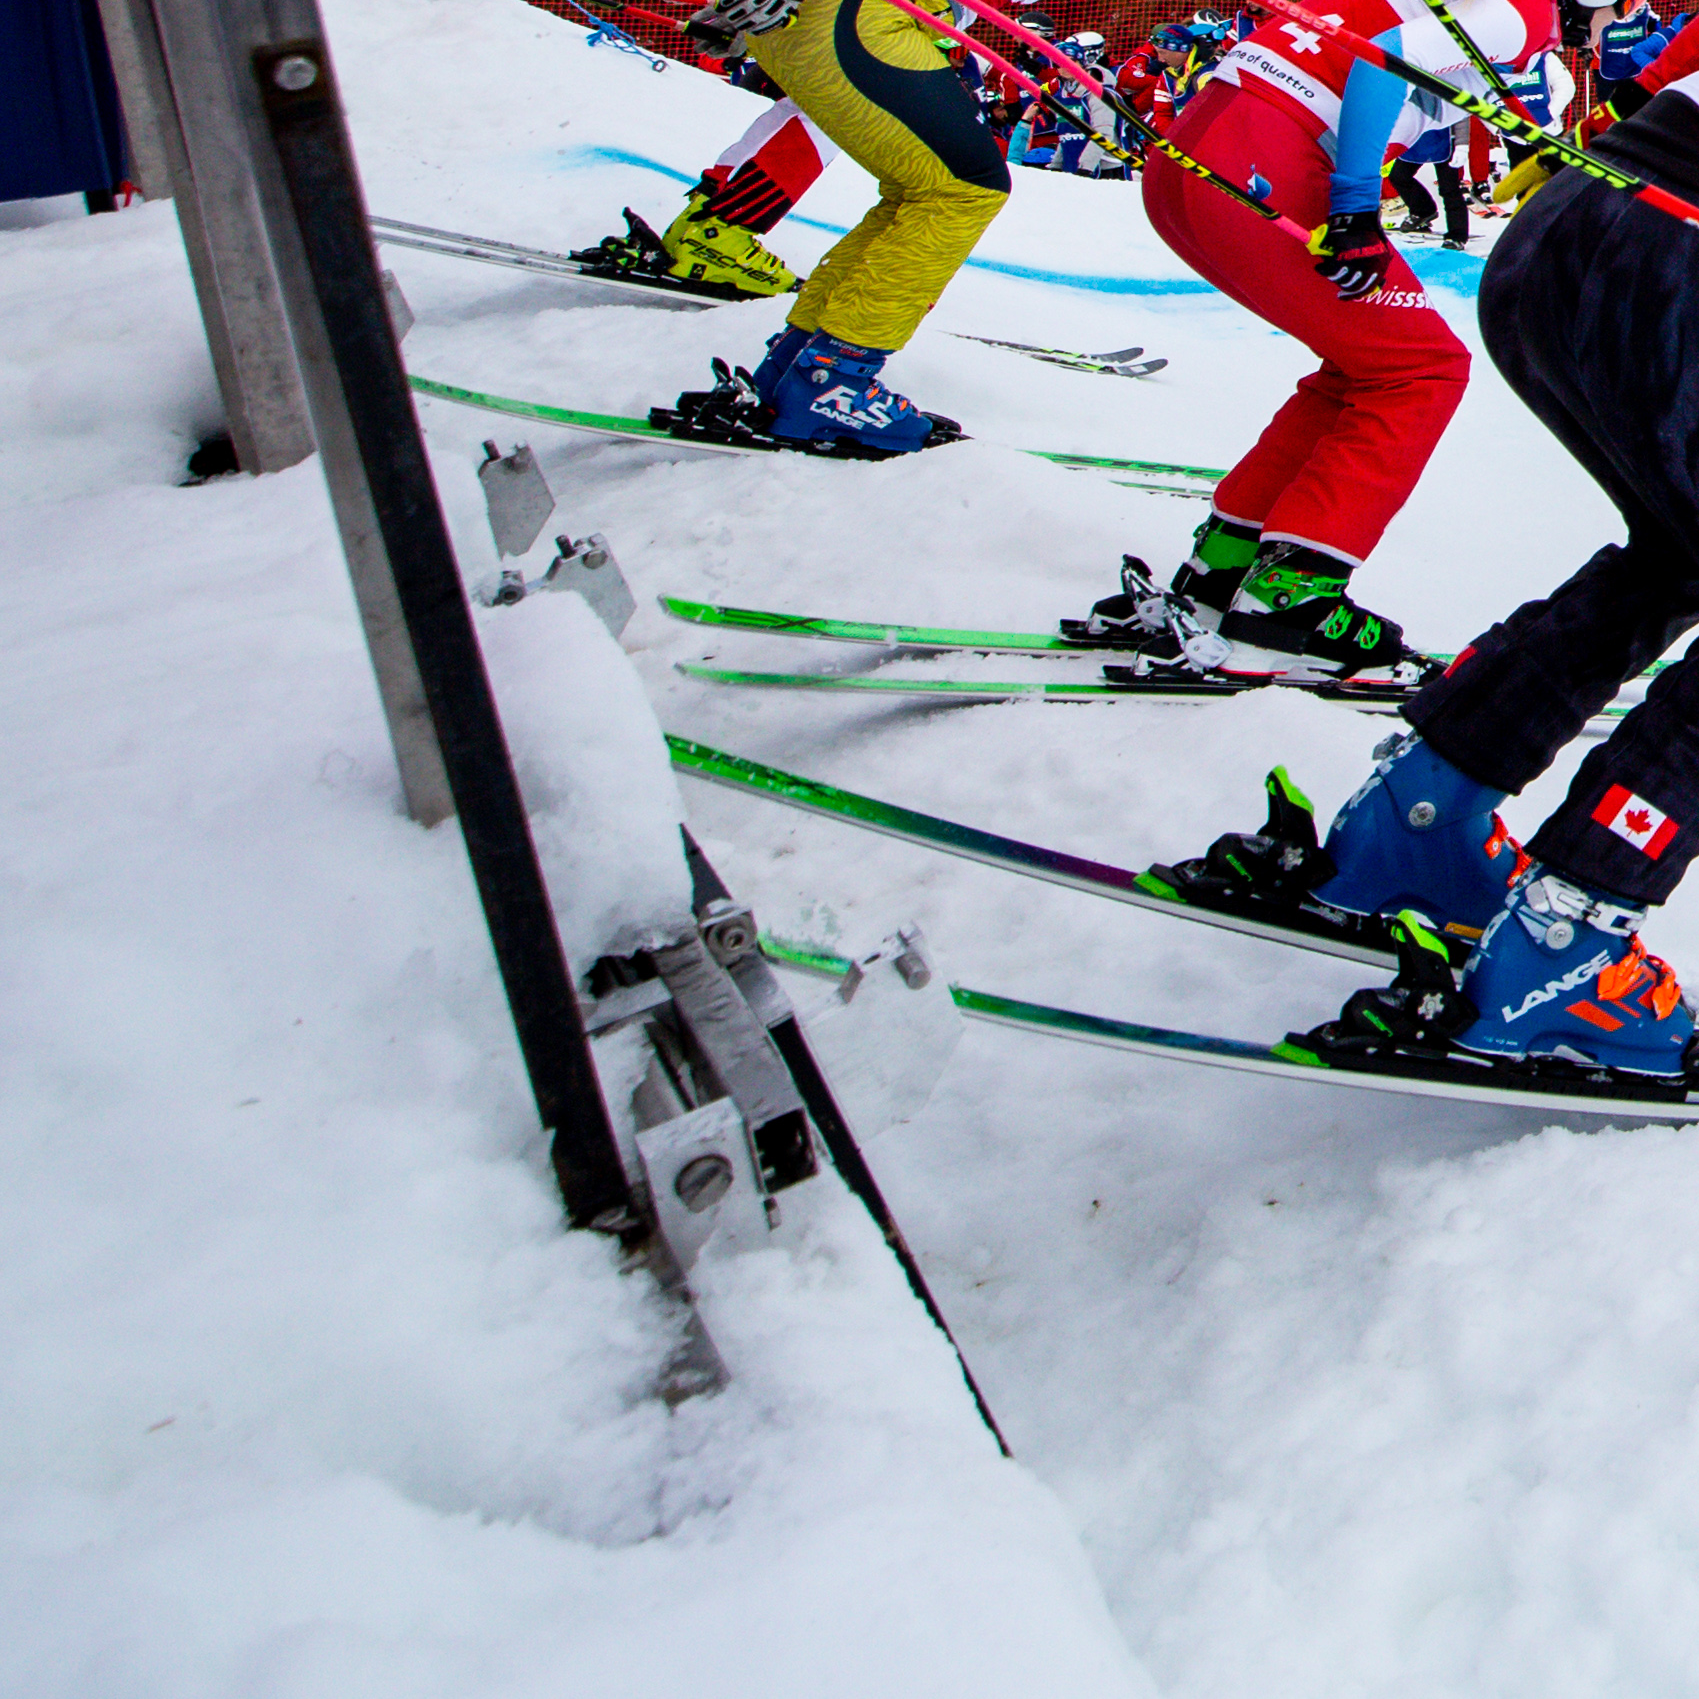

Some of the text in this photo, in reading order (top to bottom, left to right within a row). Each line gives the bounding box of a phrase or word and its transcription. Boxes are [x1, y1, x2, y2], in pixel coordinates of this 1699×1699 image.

[1246, 48, 1261, 65] of
[1260, 59, 1316, 99] quattro
[1452, 89, 1544, 142] LEKI
[1091, 132, 1145, 169] LEKI
[1155, 138, 1212, 178] LEKI
[677, 237, 781, 286] FISCHER
[809, 402, 867, 431] LANGE
[1501, 949, 1614, 1024] LANGE
